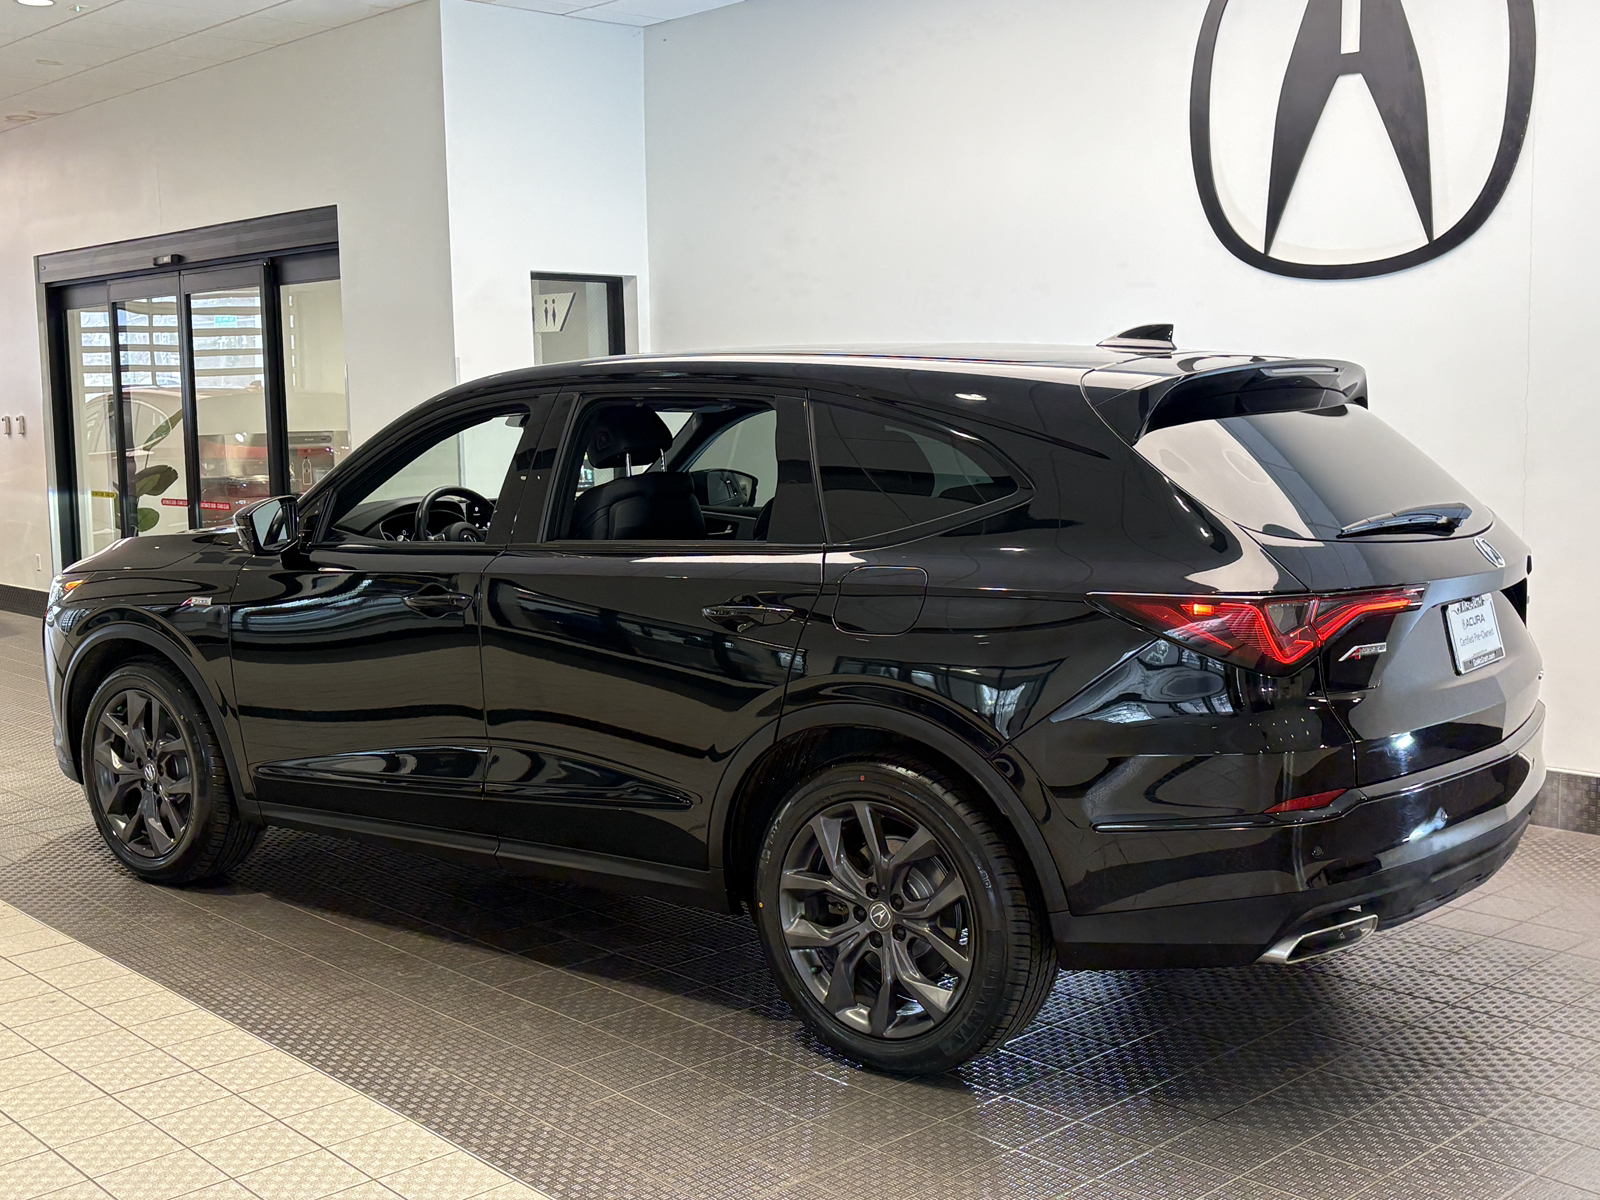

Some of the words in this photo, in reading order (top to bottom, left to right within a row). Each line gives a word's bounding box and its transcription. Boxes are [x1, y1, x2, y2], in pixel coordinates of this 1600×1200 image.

[1465, 614, 1486, 627] ACURA
[1459, 634, 1475, 647] Certified
[1474, 628, 1495, 641] Pre-Owned
